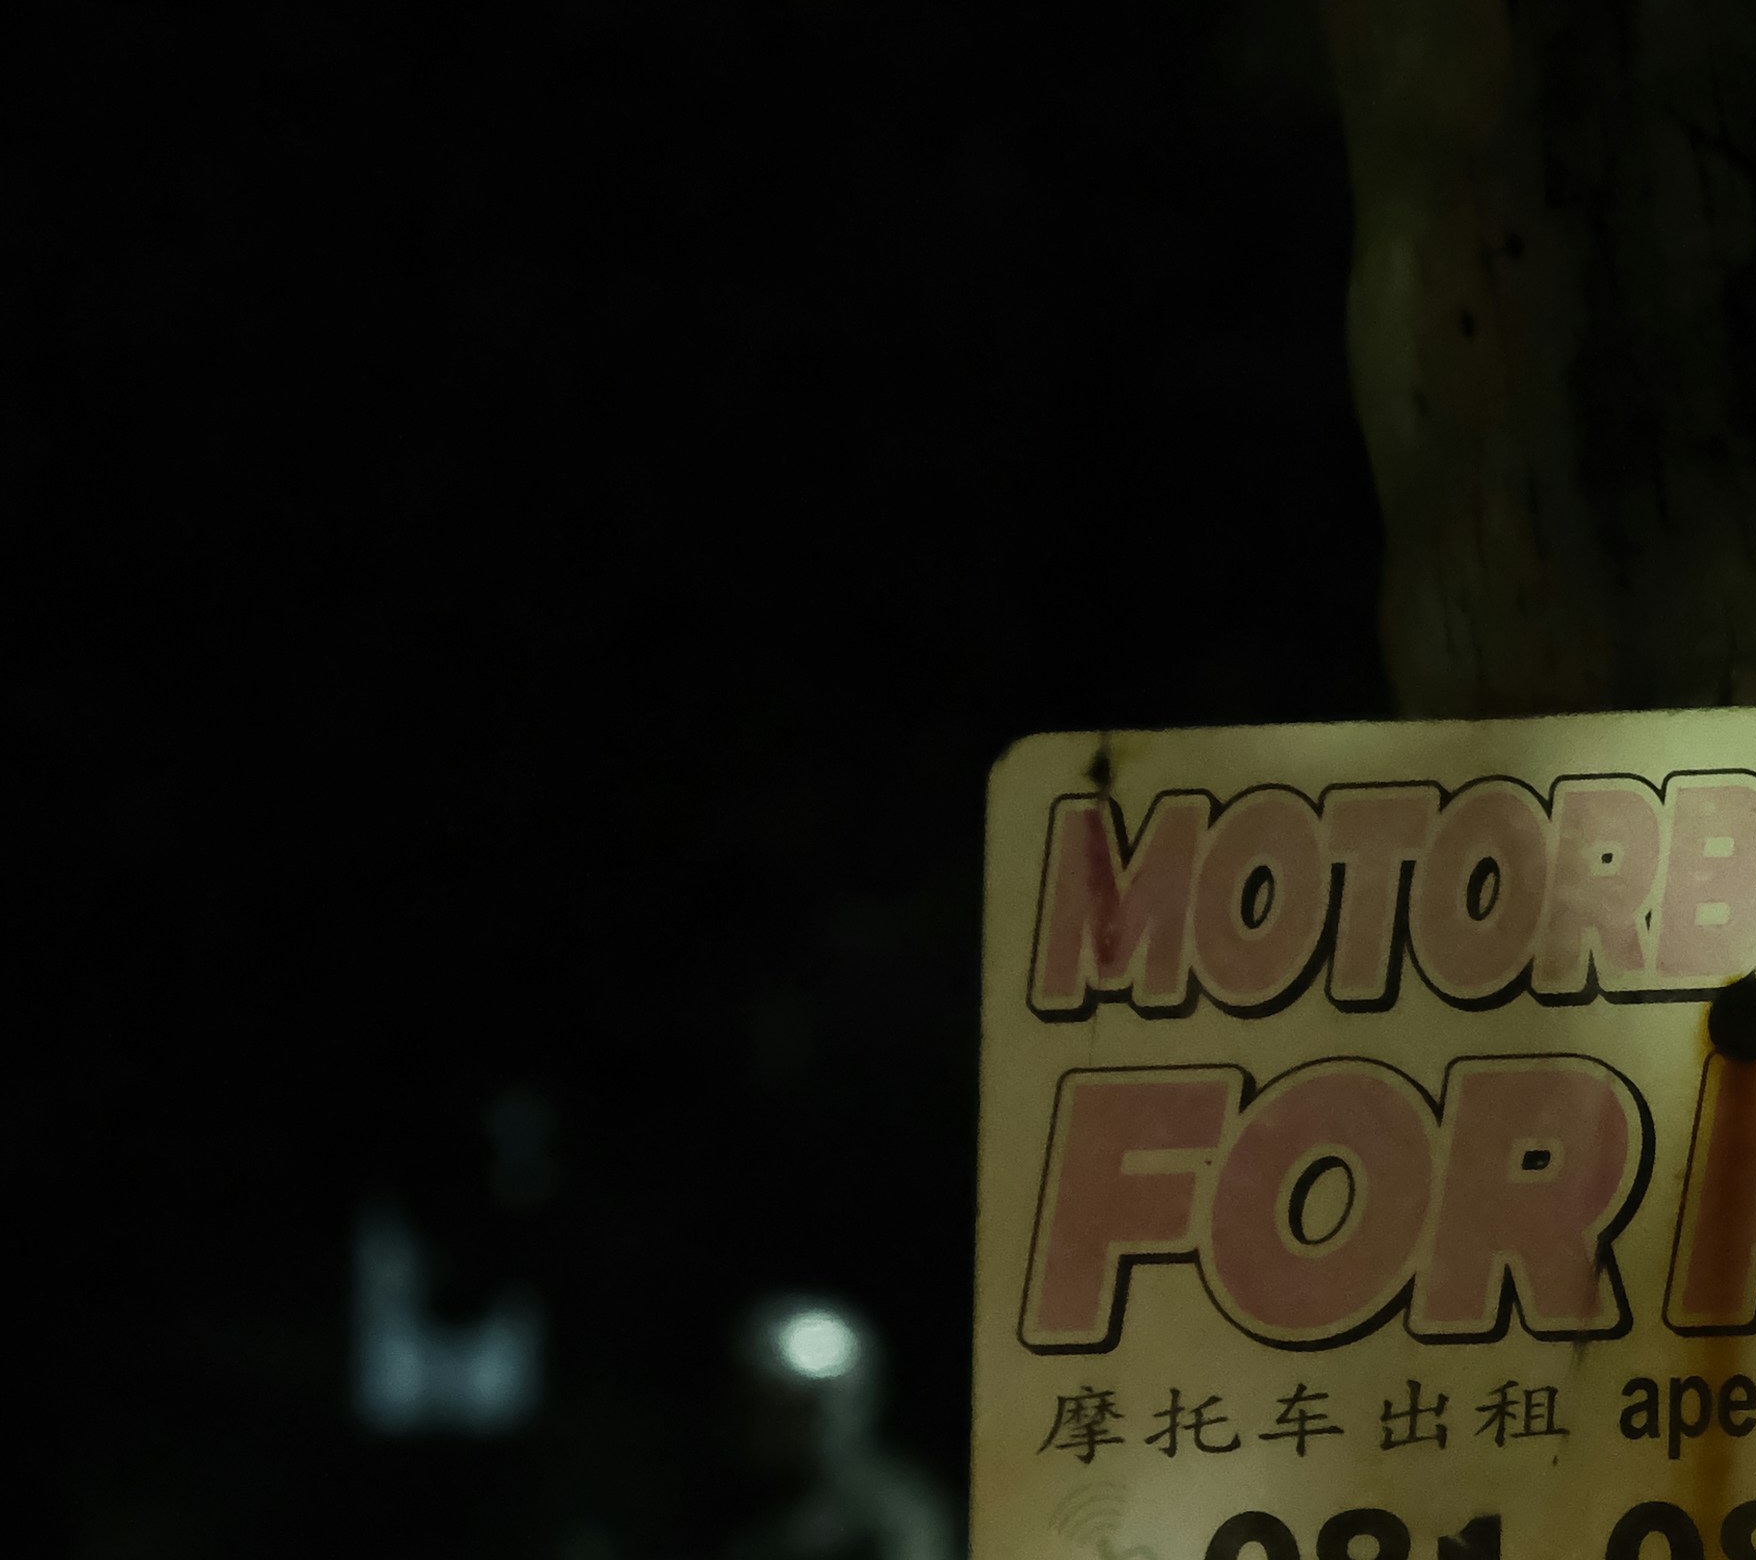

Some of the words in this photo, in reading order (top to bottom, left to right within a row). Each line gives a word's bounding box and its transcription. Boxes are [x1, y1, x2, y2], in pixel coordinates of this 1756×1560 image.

[1018, 1051, 1655, 1351] FOR
[1037, 1380, 1572, 1465] 摩托车出租
